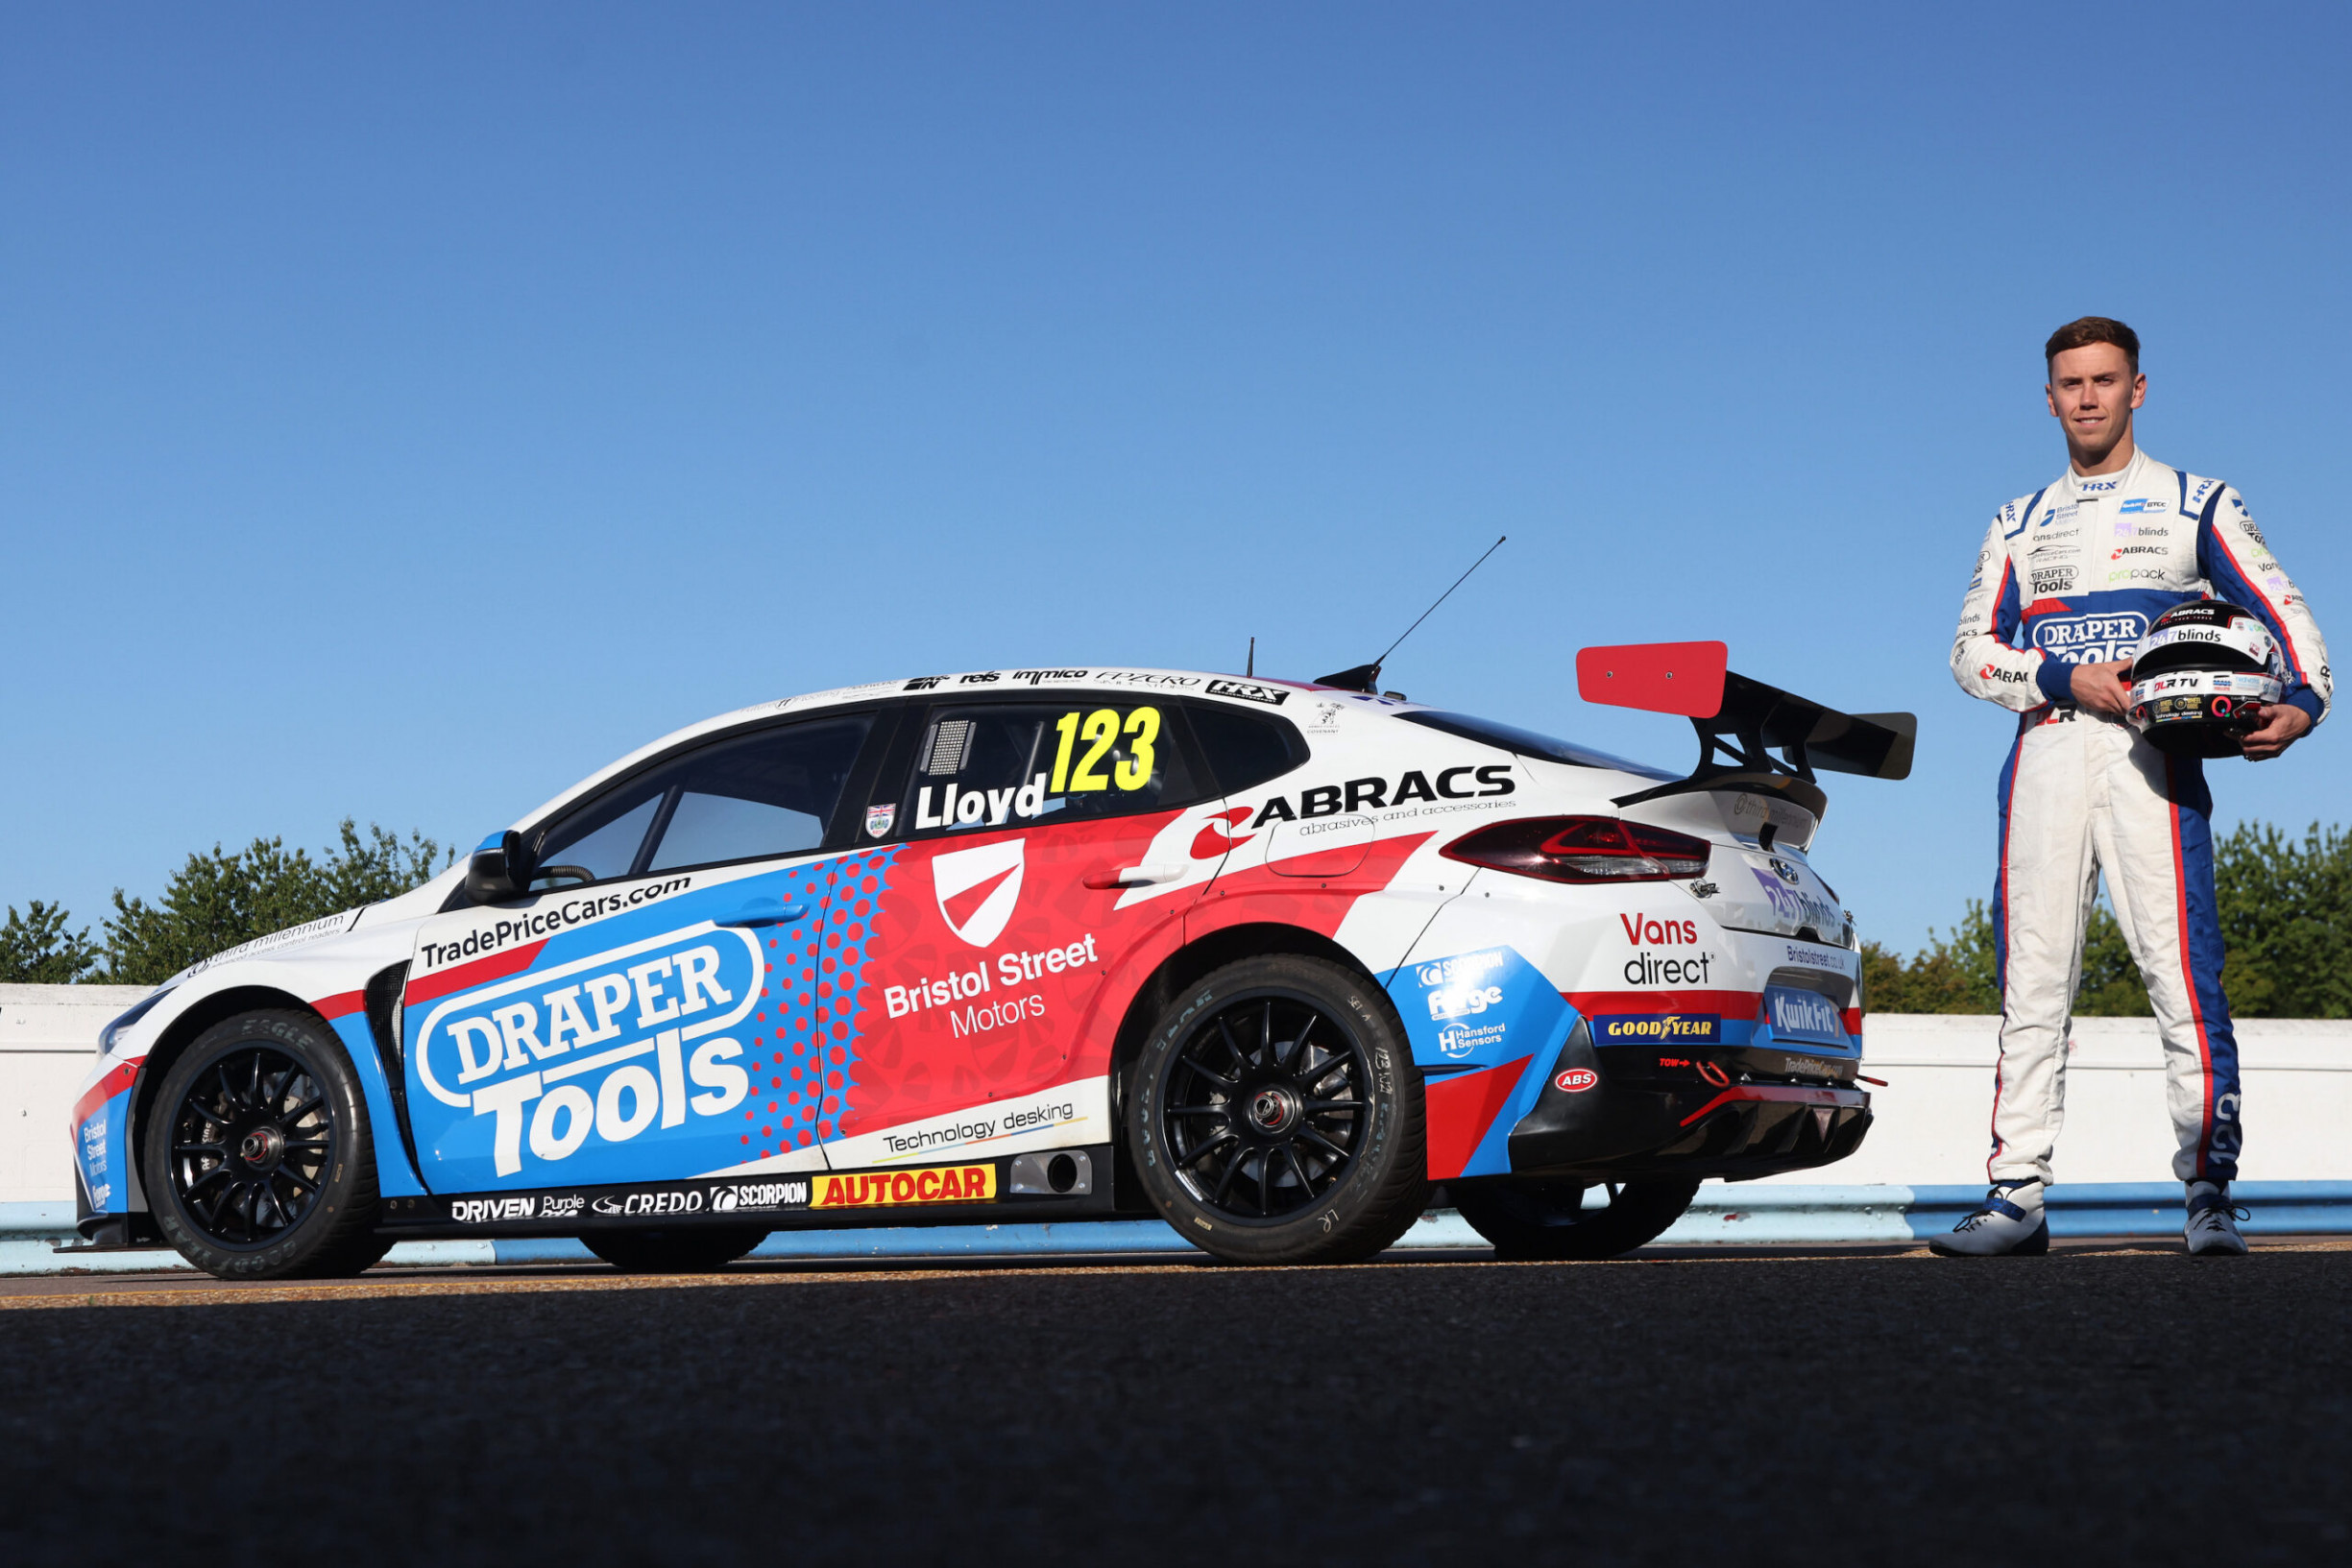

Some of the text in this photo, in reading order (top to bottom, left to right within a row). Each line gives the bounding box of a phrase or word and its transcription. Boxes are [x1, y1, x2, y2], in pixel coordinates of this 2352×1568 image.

[2082, 481, 2118, 491] HRX
[2138, 527, 2169, 537] blinds
[2122, 545, 2169, 555] ABRACS
[2031, 567, 2073, 582] DRAPER
[2032, 578, 2073, 594] Tools
[2108, 568, 2166, 583] propack
[2170, 609, 2215, 618] ABRACS
[2044, 618, 2138, 645] DRAPER
[2177, 630, 2221, 642] blinds
[1211, 681, 1287, 701] HRX
[2180, 678, 2198, 688] TV
[1050, 707, 1161, 793] 123
[915, 772, 1047, 830] Lloyd
[1250, 765, 1516, 830] ABRACS
[1299, 799, 1516, 837] abrasives and accessories
[254, 915, 344, 949] millennium
[421, 876, 691, 968] TradePriceCars.com
[1619, 912, 1698, 946] Vans
[277, 936, 307, 950] control
[308, 928, 341, 941] readers
[884, 932, 1099, 1020] Bristol Street
[1624, 952, 1709, 985] direct
[447, 945, 732, 1085] DRAPER
[950, 994, 1045, 1039] Motors
[1456, 1023, 1506, 1040] Hansford
[1457, 1034, 1502, 1049] Sensors
[1660, 1058, 1680, 1068] TOW
[1561, 1073, 1592, 1087] ABS
[473, 1027, 749, 1178] Tools
[84, 1118, 107, 1144] Bristol
[883, 1103, 1074, 1153] Technology desking
[86, 1139, 107, 1161] Street
[740, 1181, 807, 1208] SCORPION
[820, 1168, 986, 1206] AUTOCAR
[451, 1197, 535, 1222] DRIVEN
[543, 1194, 585, 1213] Purple
[624, 1191, 702, 1215] CREDO
